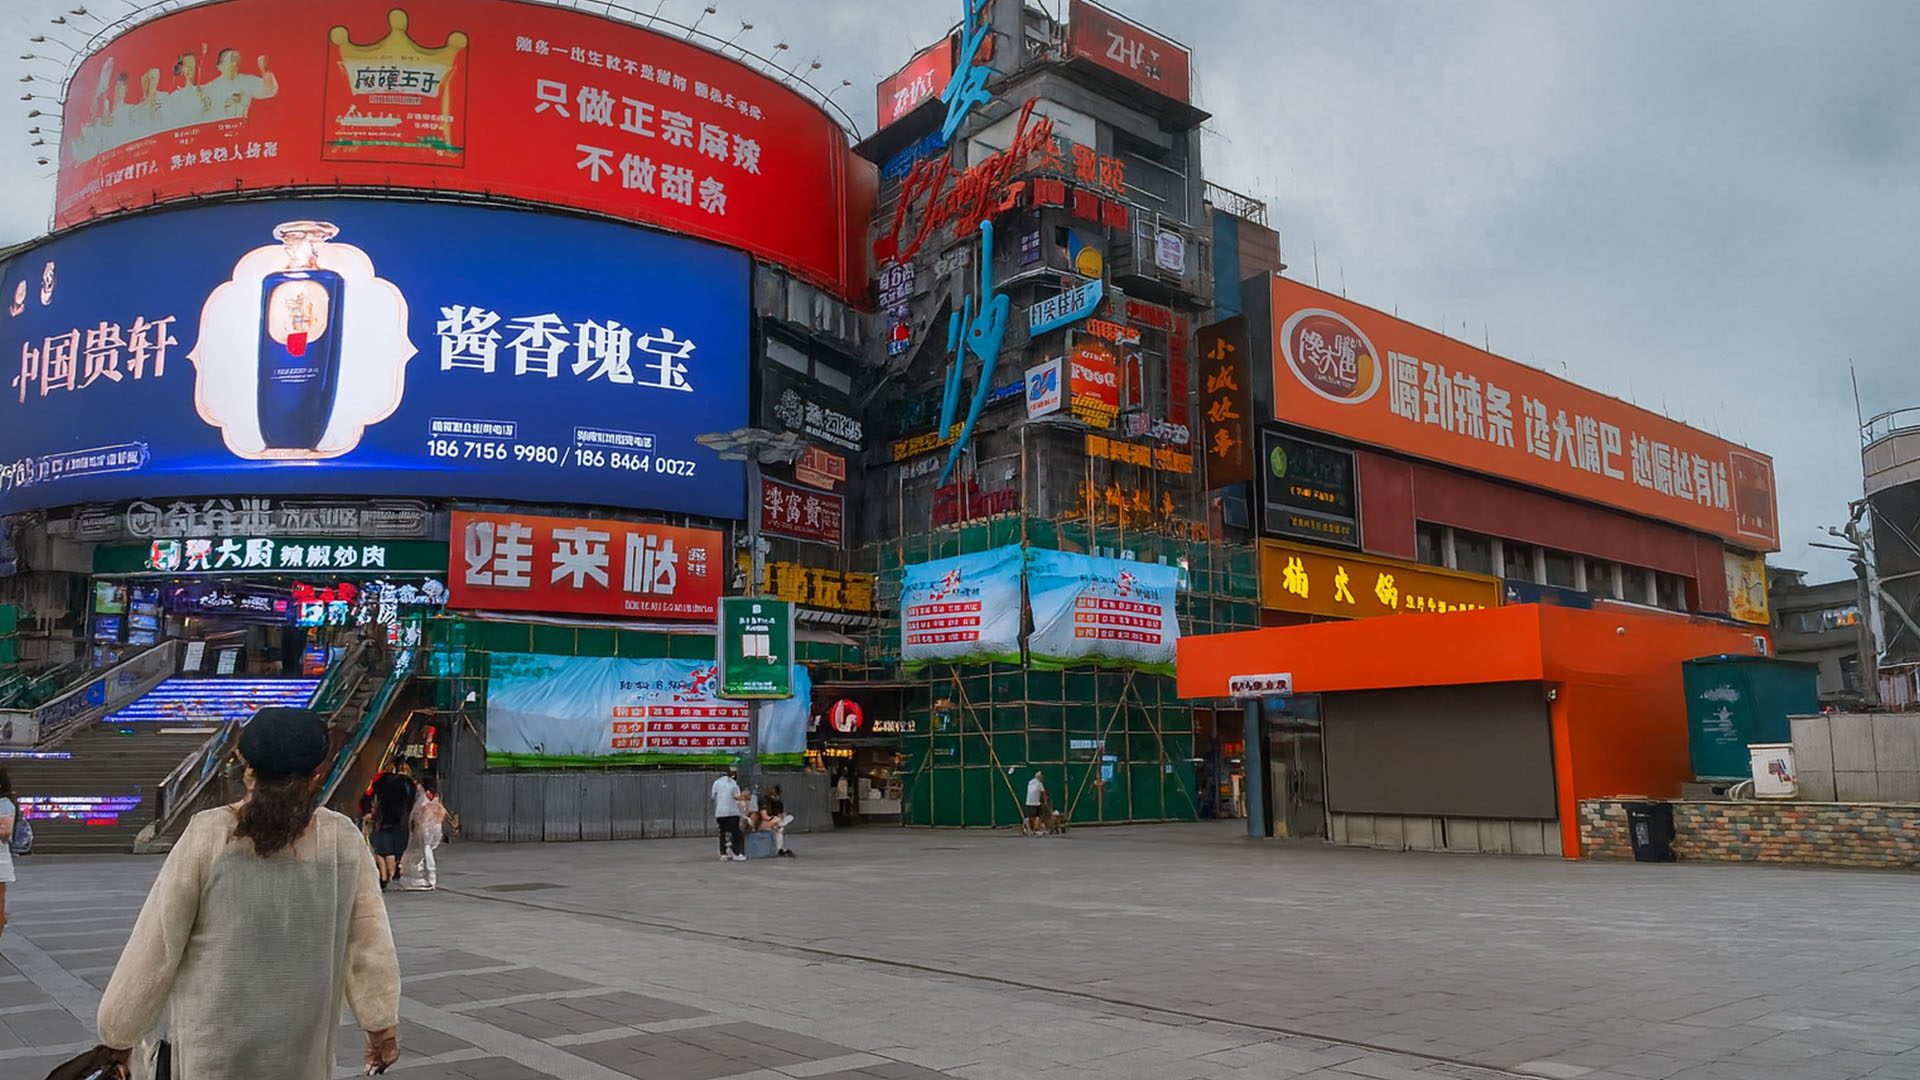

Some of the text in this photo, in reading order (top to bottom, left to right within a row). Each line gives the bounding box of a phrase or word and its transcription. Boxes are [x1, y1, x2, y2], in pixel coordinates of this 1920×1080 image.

[534, 78, 762, 175] 只做正宗麻辣
[436, 304, 696, 392] 酱香瑰宝
[427, 440, 459, 458] 186
[464, 441, 508, 460] 7156
[513, 444, 558, 464] 9980
[574, 448, 604, 467] 186
[610, 451, 649, 473] 8464
[655, 457, 696, 476] 0022
